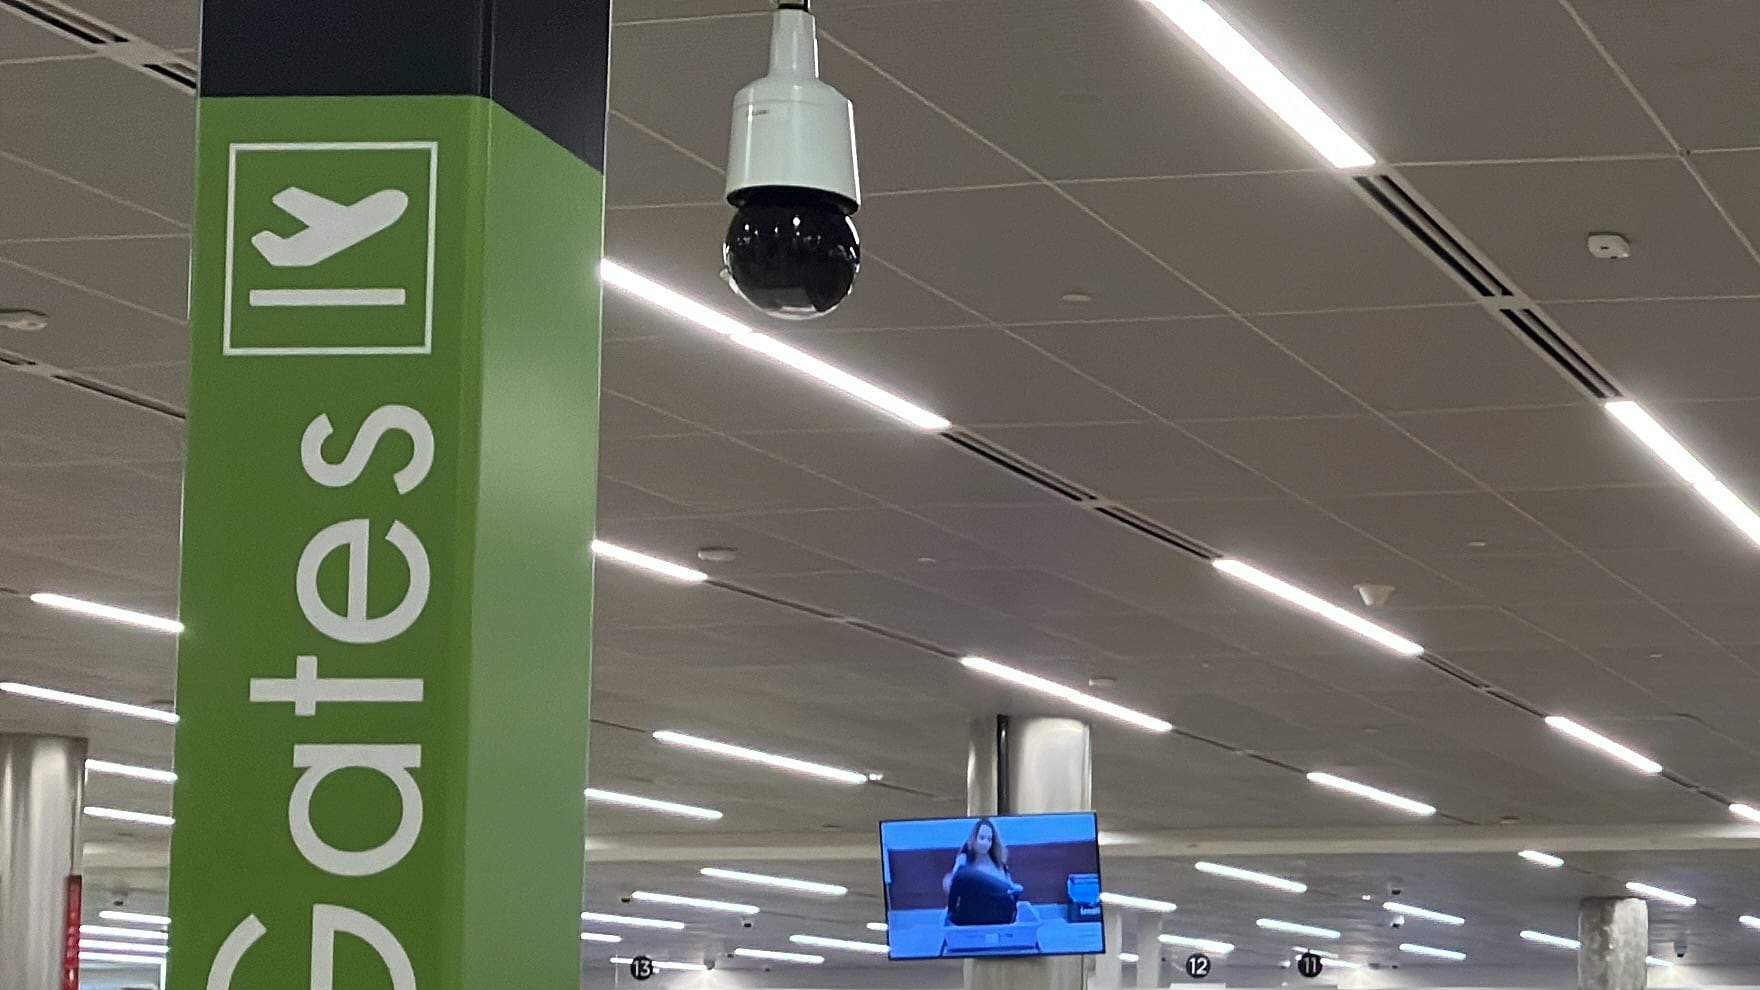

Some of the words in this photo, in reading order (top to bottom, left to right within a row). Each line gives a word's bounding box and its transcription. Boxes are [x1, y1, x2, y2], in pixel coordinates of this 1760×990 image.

[632, 960, 651, 976] 13
[1188, 957, 1208, 975] 12
[1303, 956, 1318, 974] 11
